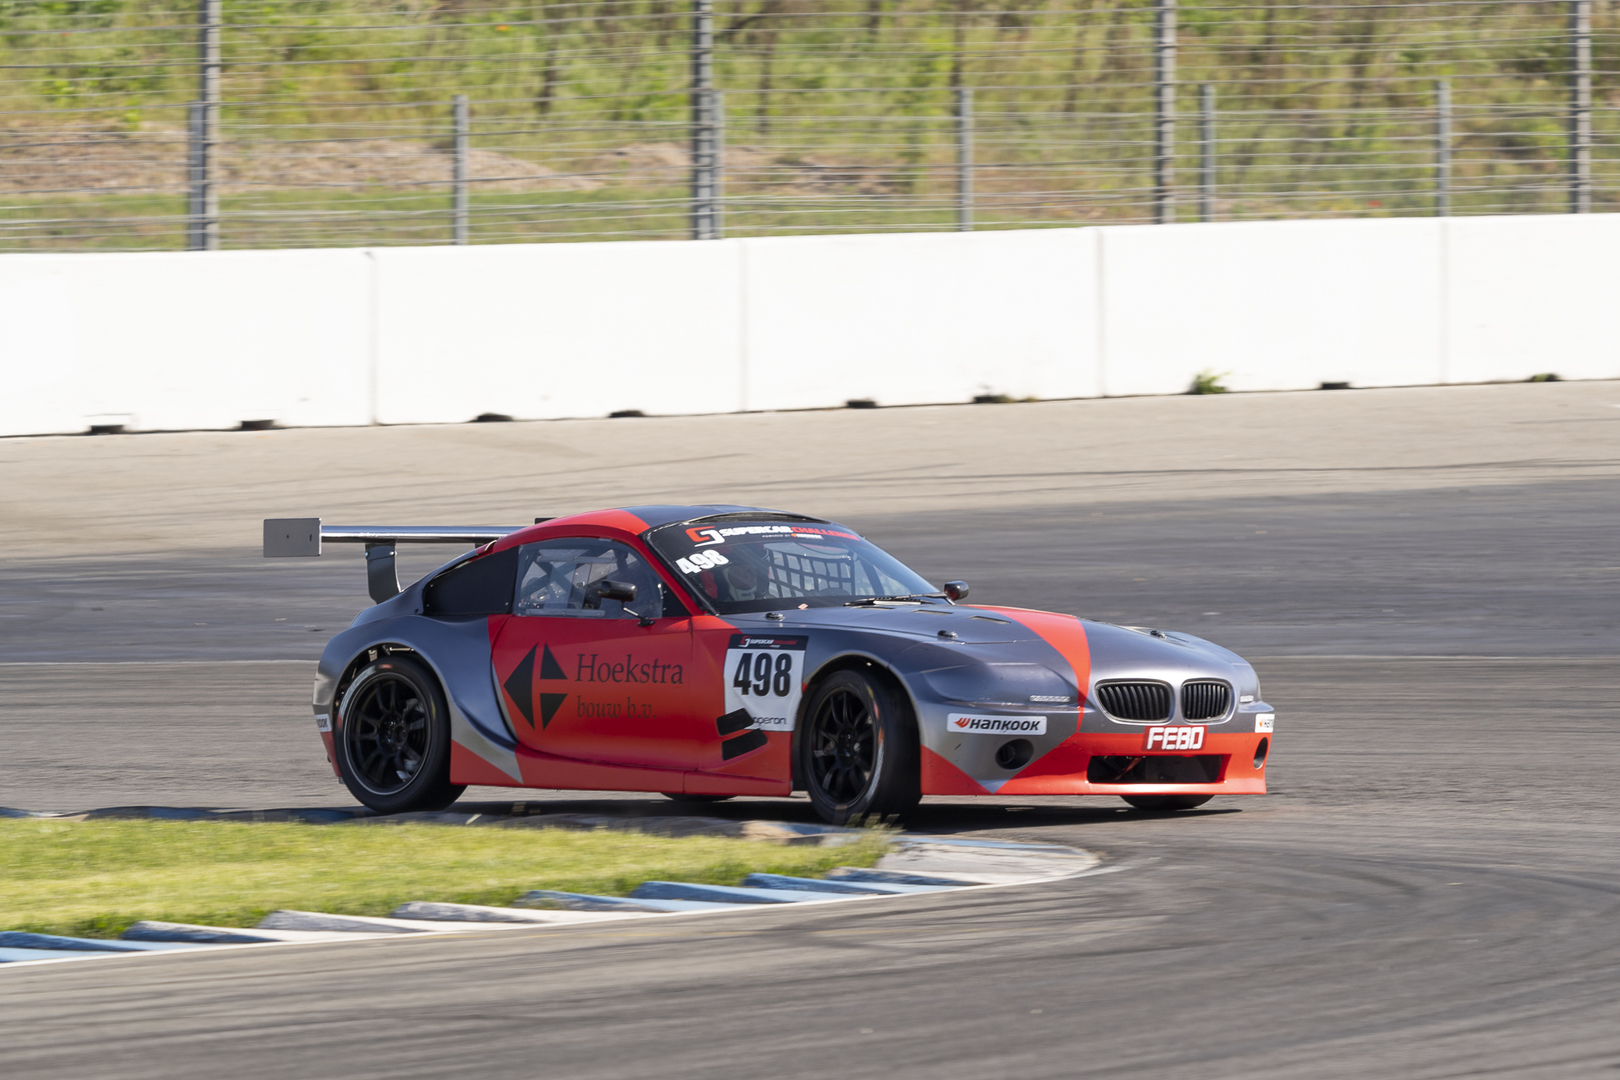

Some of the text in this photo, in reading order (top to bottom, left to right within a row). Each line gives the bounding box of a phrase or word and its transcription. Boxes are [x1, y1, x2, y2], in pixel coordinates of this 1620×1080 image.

[675, 549, 730, 575] 498
[575, 653, 684, 685] Hoekstra
[733, 652, 793, 698] 498
[577, 695, 657, 719] bouw b.v.
[1146, 726, 1205, 750] FEBO
